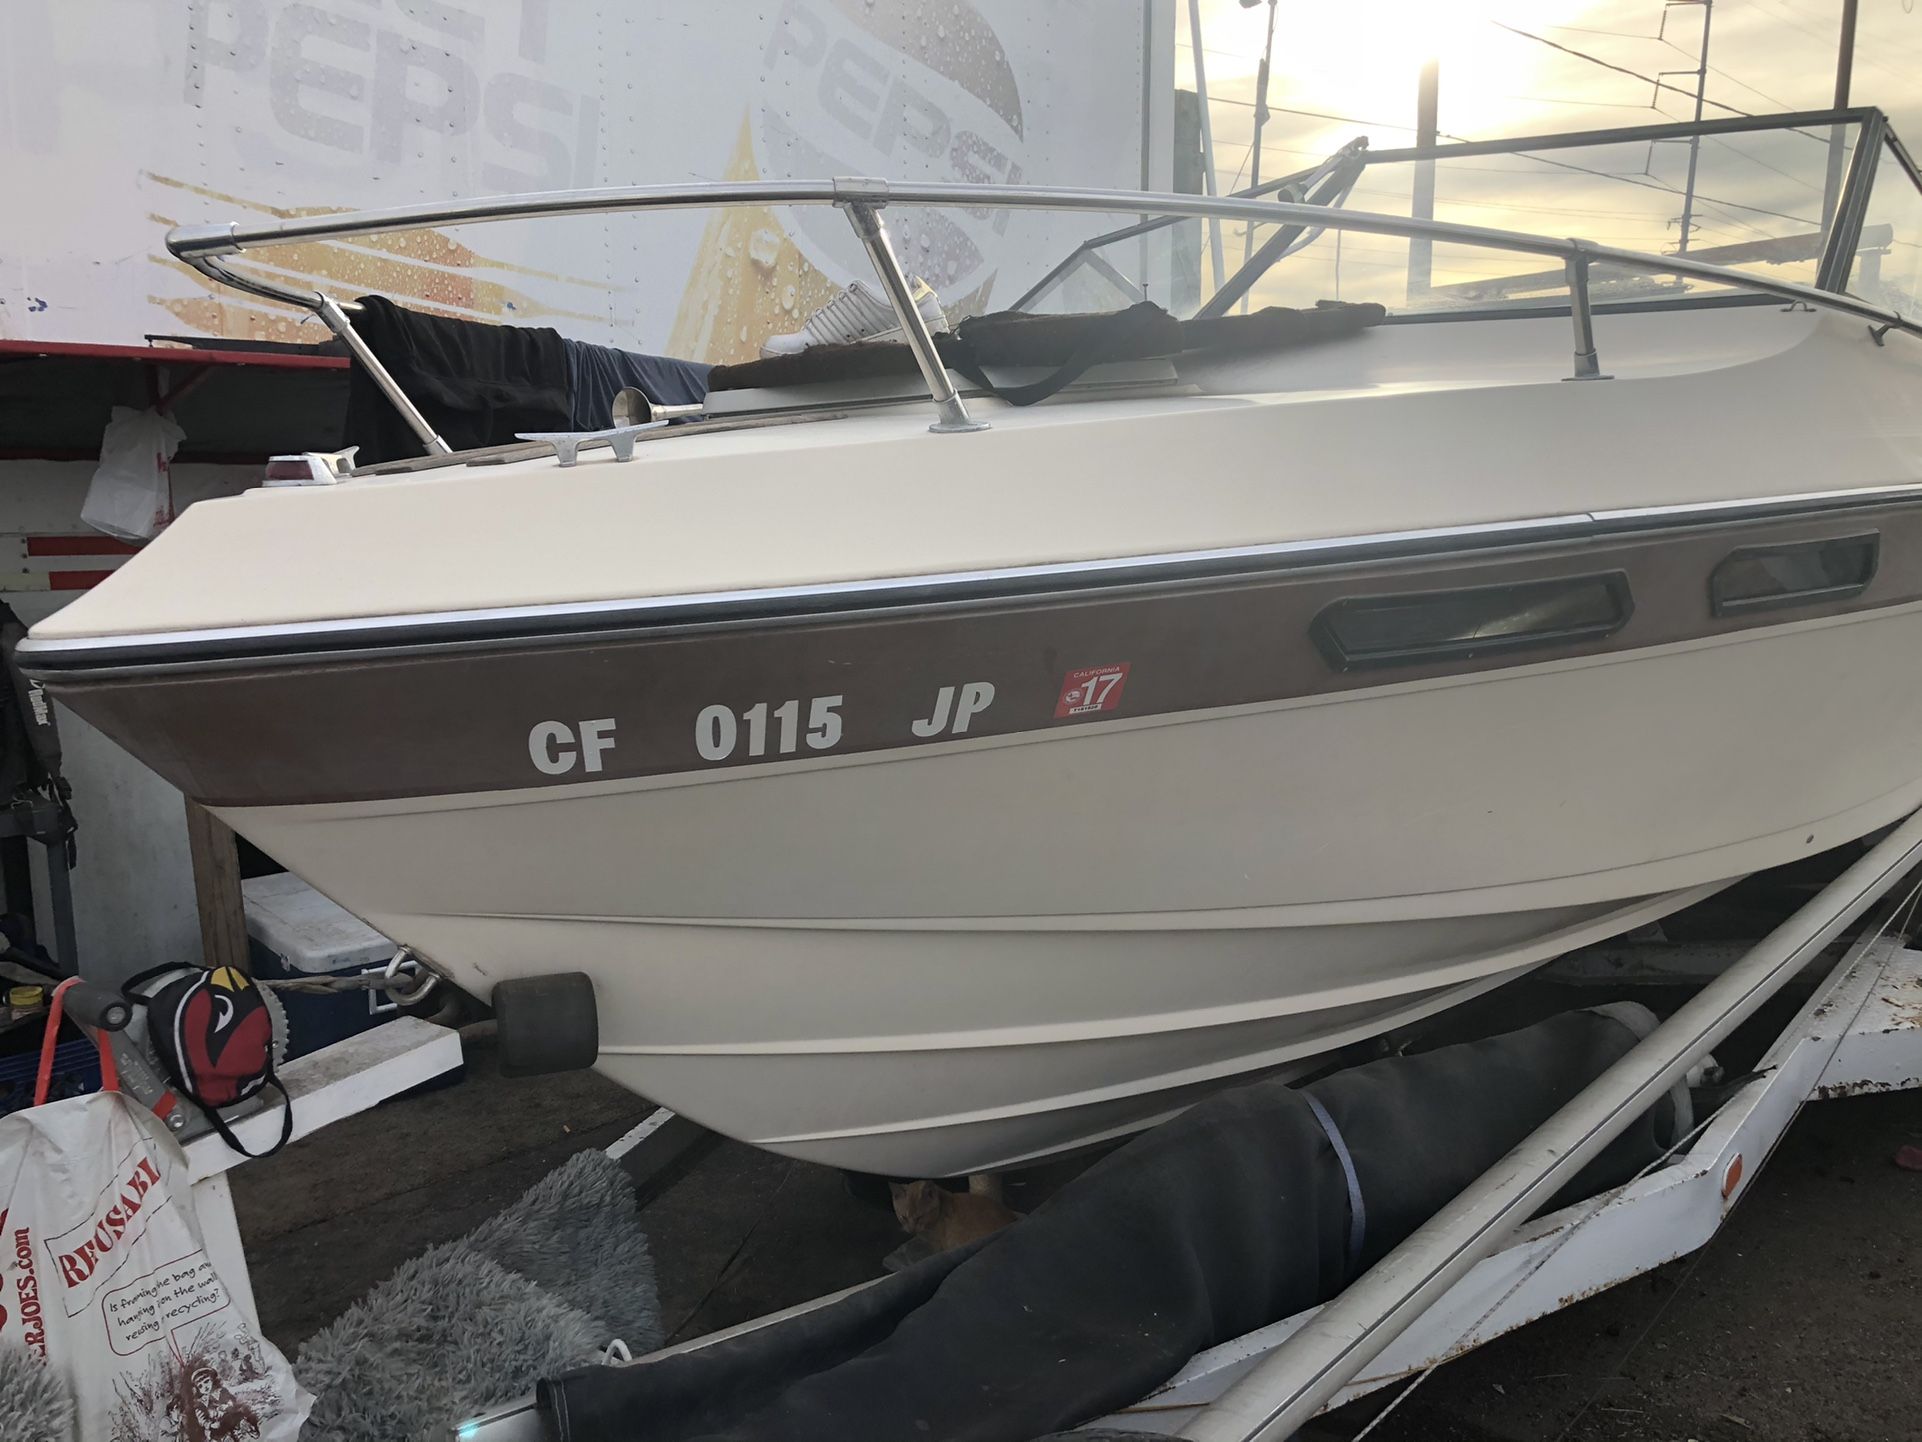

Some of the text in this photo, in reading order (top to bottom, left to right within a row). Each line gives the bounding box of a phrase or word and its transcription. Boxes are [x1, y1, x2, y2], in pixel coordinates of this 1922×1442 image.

[1073, 666, 1120, 679] CALIFORNIA
[1081, 672, 1124, 706] 17
[527, 681, 996, 774] CF 0115 JP
[172, 1268, 195, 1282] bag
[173, 1285, 195, 1298] the
[197, 1271, 218, 1289] wall
[166, 1288, 220, 1319] recycling?
